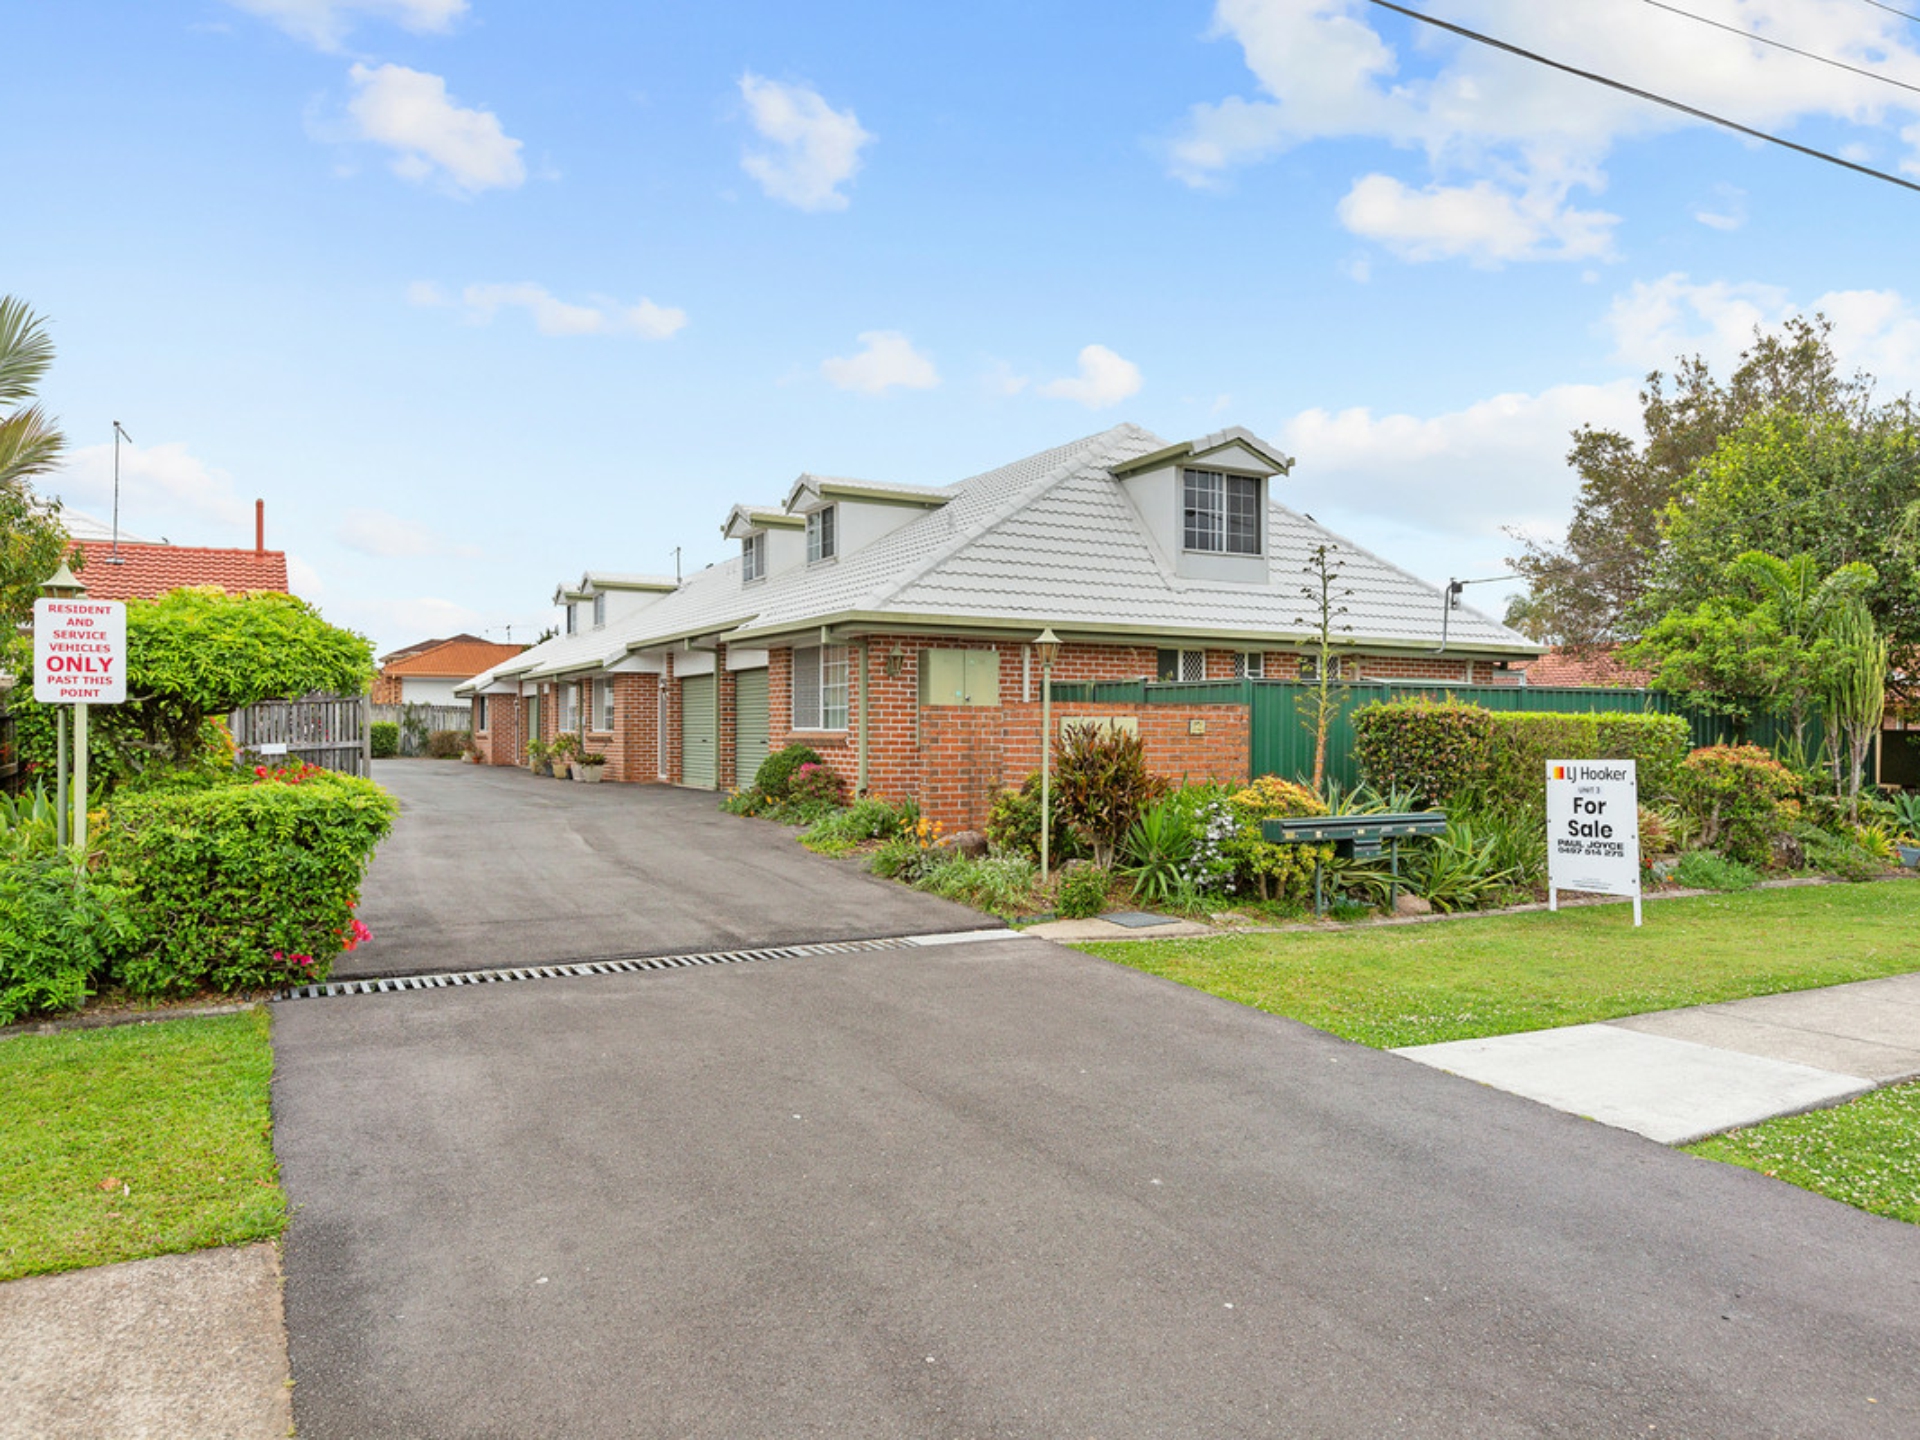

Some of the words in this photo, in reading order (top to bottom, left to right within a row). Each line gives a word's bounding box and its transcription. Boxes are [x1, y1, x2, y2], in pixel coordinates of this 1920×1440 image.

[48, 604, 111, 614] RESIDENT
[66, 618, 94, 627] AND
[53, 630, 107, 640] SERVICE
[49, 643, 111, 653] VEHICLES
[46, 655, 114, 673] ONLY
[47, 675, 78, 684] PAST
[82, 676, 113, 685] THIS
[60, 688, 100, 697] POINT
[1566, 766, 1577, 784] LJ
[1580, 766, 1627, 781] Hooker
[1573, 797, 1607, 815] For
[1568, 819, 1613, 839] Sale
[1586, 840, 1624, 851] JOYCE
